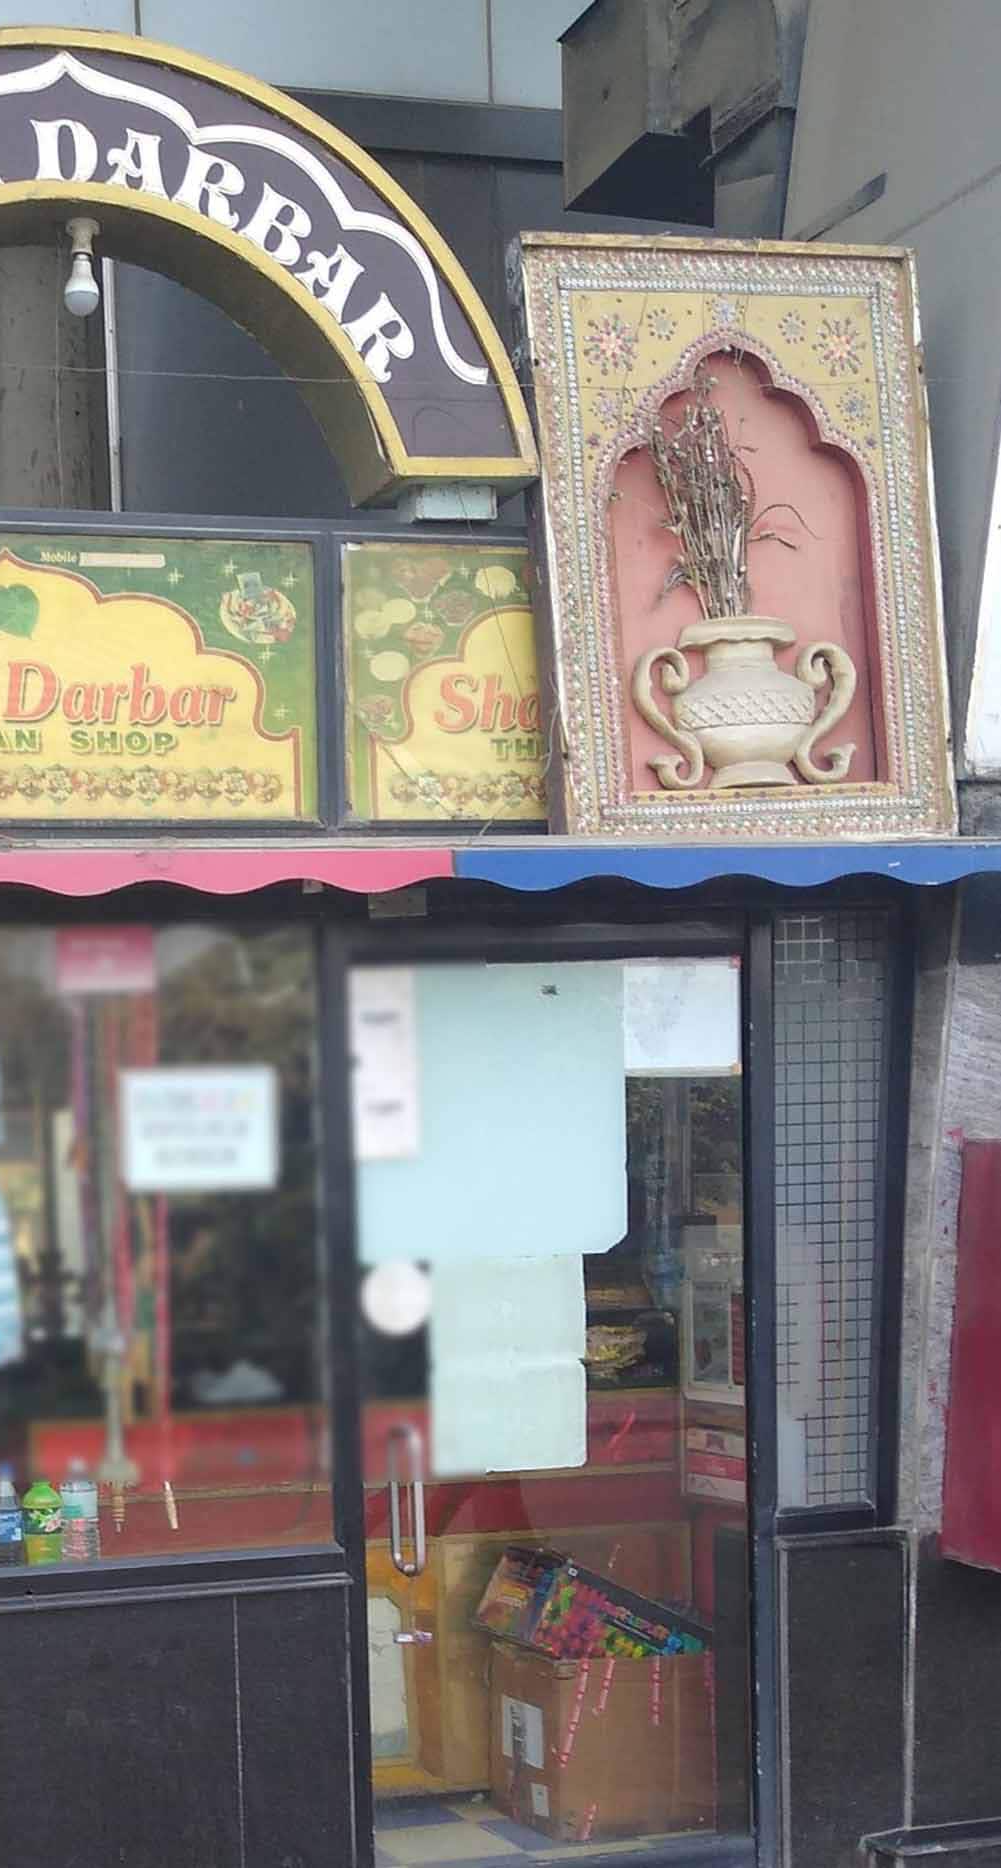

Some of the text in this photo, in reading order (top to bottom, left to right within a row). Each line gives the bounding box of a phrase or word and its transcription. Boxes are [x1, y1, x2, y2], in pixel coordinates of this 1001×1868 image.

[30, 118, 415, 384] DARBAR
[40, 551, 78, 563] Mobile
[2, 659, 237, 727] Darbar
[69, 730, 179, 756] SHOP
